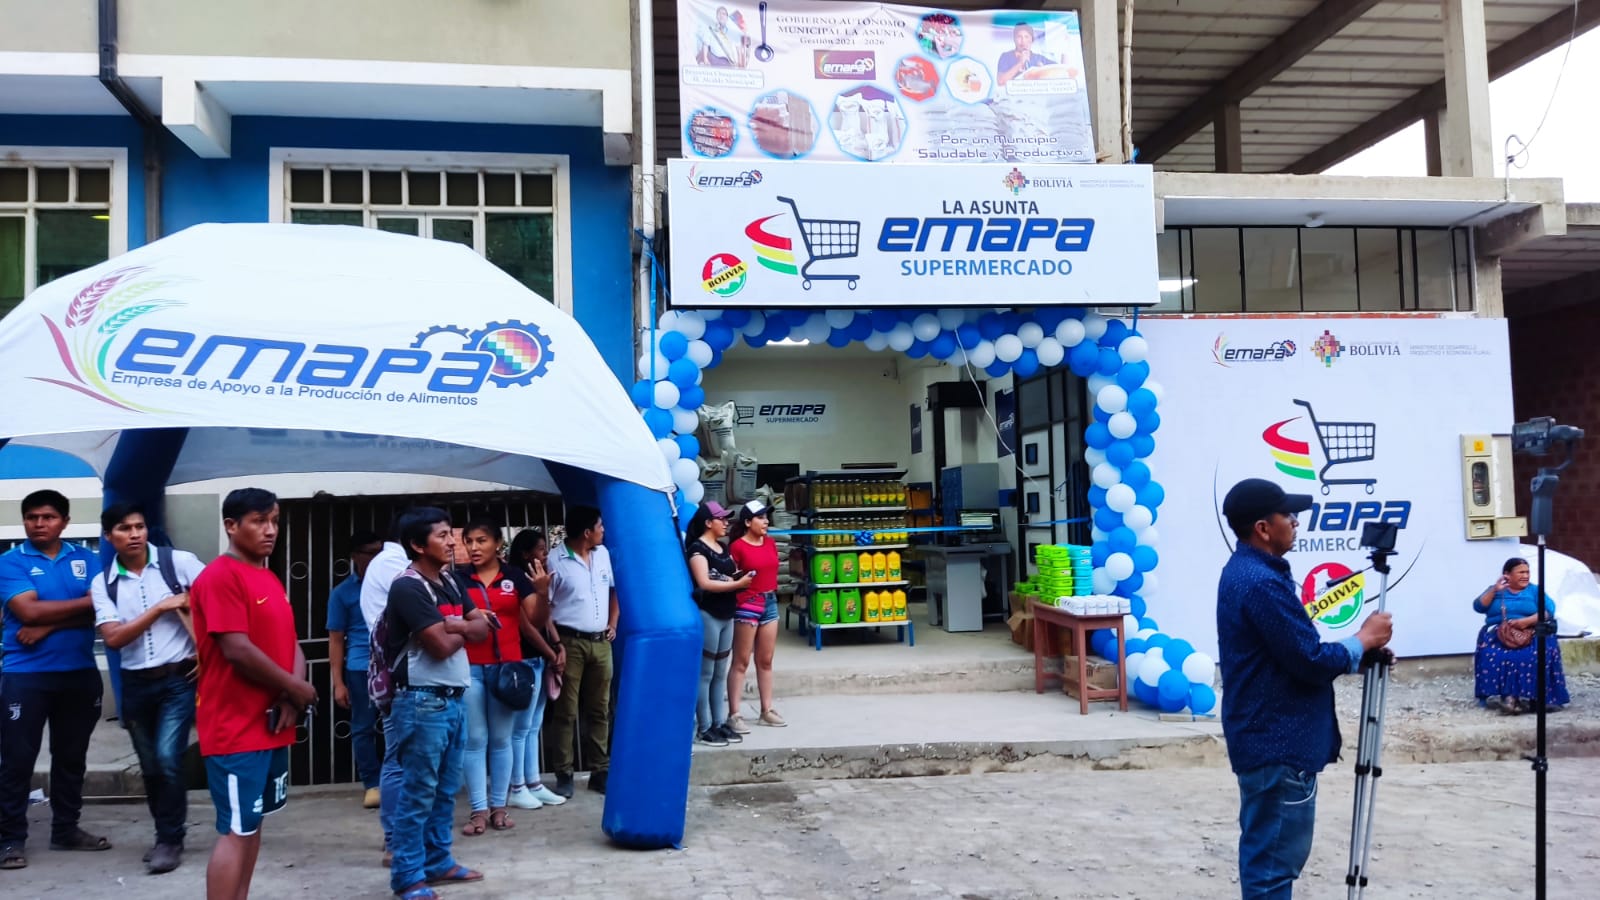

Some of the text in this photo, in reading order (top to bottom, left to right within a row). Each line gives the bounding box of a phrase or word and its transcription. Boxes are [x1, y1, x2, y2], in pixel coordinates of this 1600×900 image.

[776, 15, 836, 25] GOBIERNO
[778, 25, 905, 38] MUNICIPAL LA ASUNTA
[941, 135, 1057, 146] Por un Municipio
[992, 151, 999, 160] y
[1032, 179, 1073, 188] BOLIVIA
[942, 200, 1040, 215] LA ASUNTA
[900, 259, 1073, 276] SUPERMERCADO
[708, 265, 745, 288] BOLIVIA
[1349, 344, 1401, 356] BOLIVIA
[111, 371, 478, 407] Empresa de Apoyo a la Producción de Alimentos
[765, 416, 819, 424] SUPERMERCADO
[1309, 580, 1361, 616] BOLIVIA
